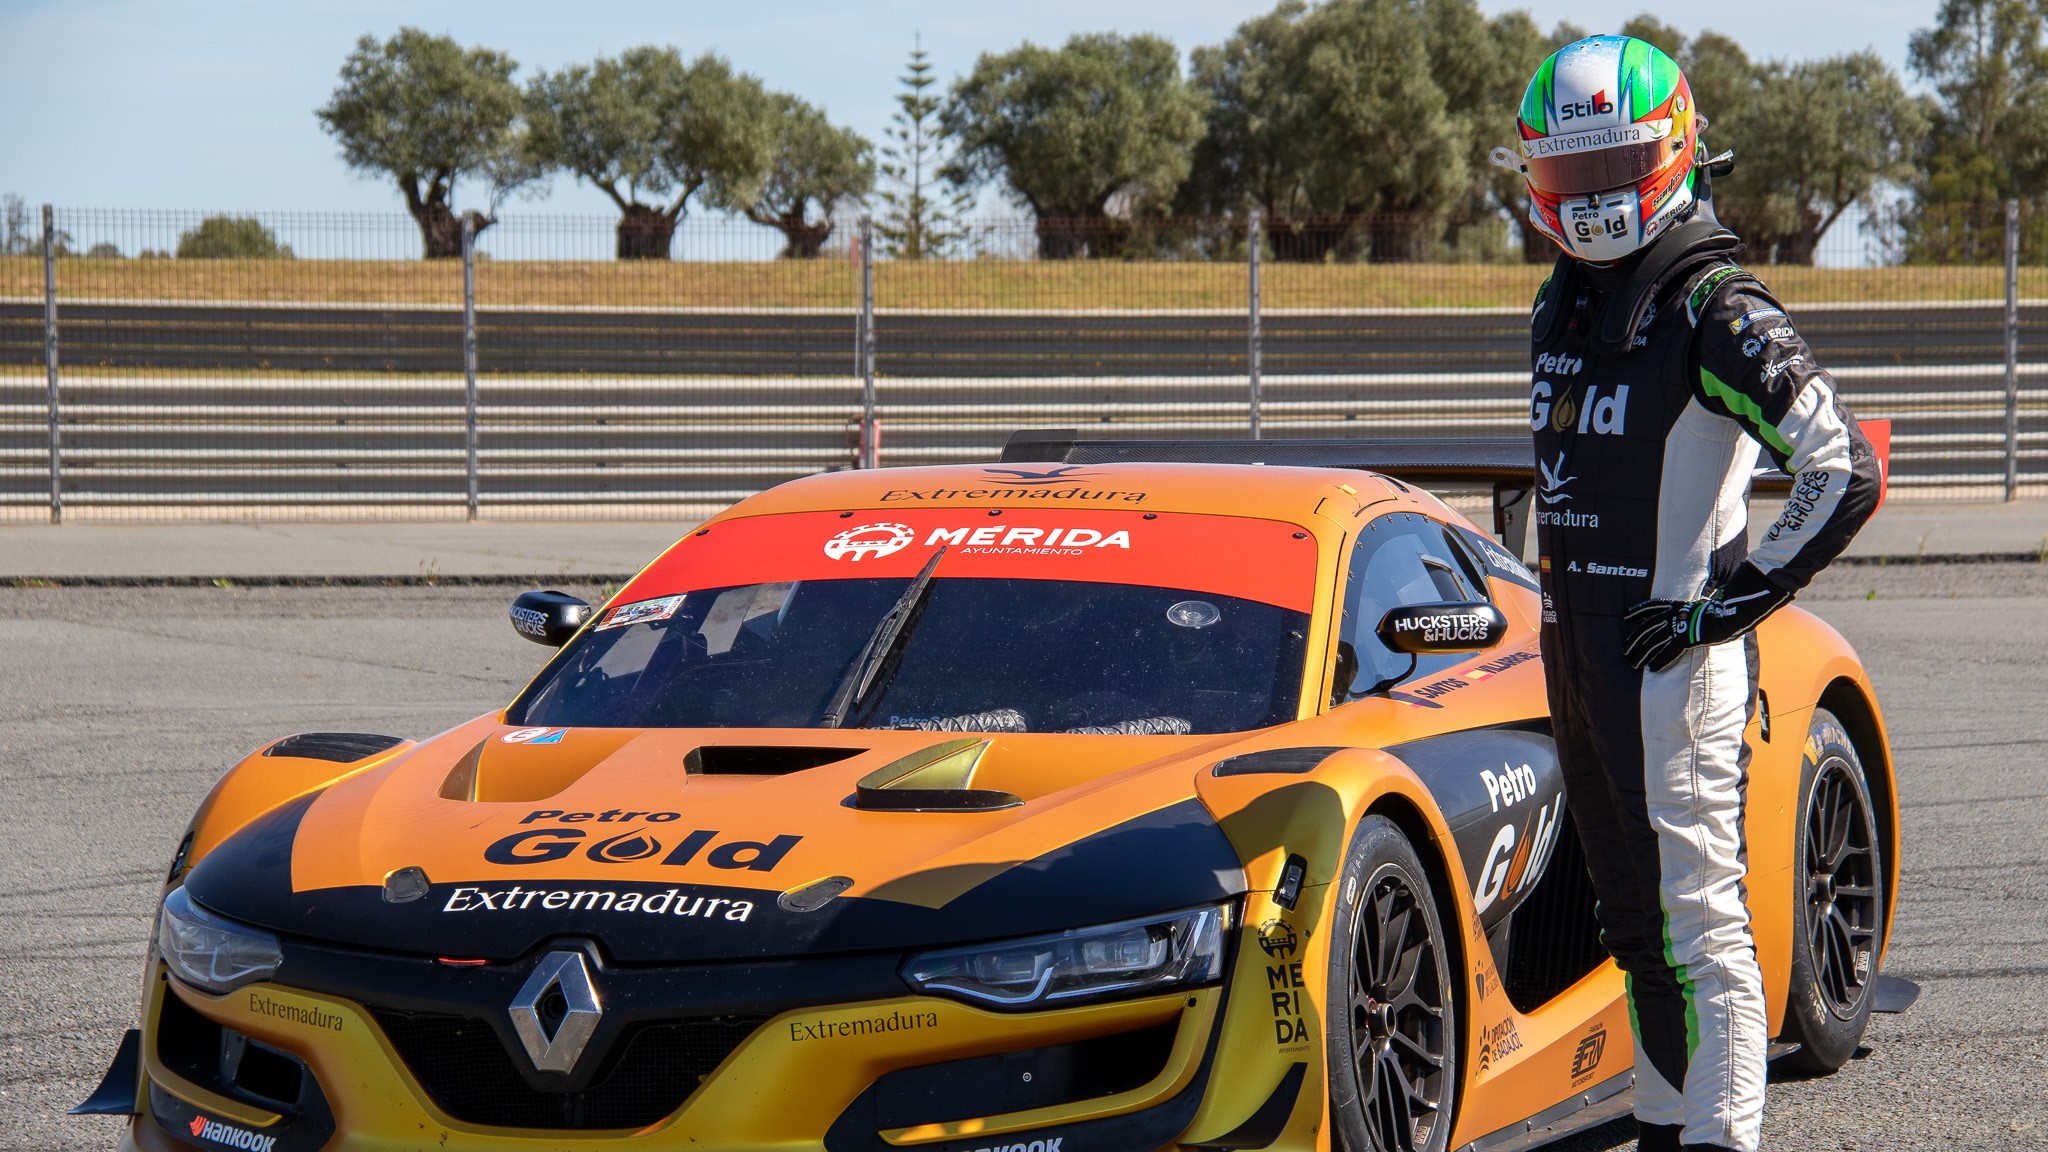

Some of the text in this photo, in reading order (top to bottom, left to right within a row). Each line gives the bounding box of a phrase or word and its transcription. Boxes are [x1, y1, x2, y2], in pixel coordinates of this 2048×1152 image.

[1561, 92, 1614, 121] Stilo
[1537, 127, 1641, 156] Extremadura
[1572, 211, 1600, 221] Petro
[1535, 352, 1583, 376] Petro
[879, 486, 1151, 505] Extremadura
[923, 524, 1131, 549] MÉRIDA
[960, 547, 1083, 557] AYUNTAMIENTO
[1567, 560, 1649, 578] A. Santos
[1395, 614, 1489, 632] HUCKSTERS
[1423, 627, 1489, 642] &HUCKS
[1413, 677, 1470, 699] SANTOS
[1479, 761, 1537, 813] Petro
[518, 808, 682, 824] Petro
[442, 886, 755, 923] Extremadura
[249, 993, 344, 1032] Extremadura
[789, 1012, 939, 1042] Extremadura
